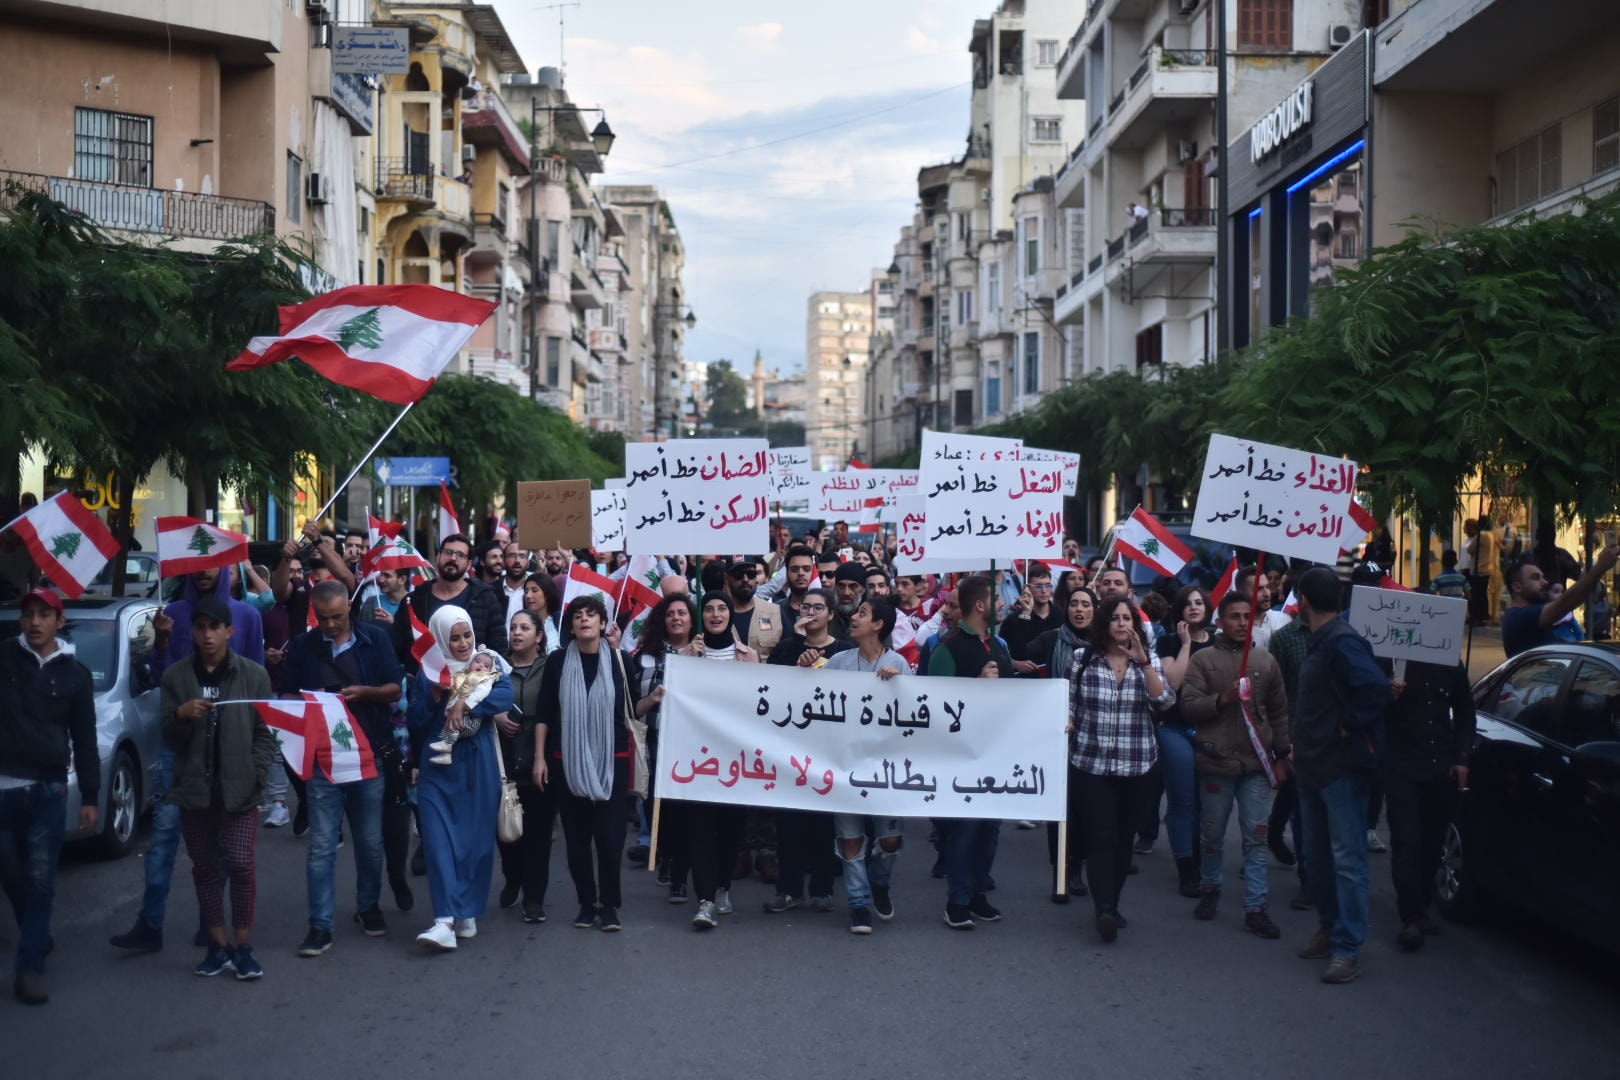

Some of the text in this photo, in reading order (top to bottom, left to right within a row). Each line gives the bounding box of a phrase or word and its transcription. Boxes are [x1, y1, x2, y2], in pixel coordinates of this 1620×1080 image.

[1251, 81, 1313, 163] NABOULSI
[626, 446, 668, 488] أحمر
[670, 456, 698, 479] خط
[700, 450, 767, 481] الضمان
[821, 475, 860, 496] للظلم
[928, 464, 1062, 499] الشغل خط أحمر
[1209, 446, 1354, 494] الغذاء خط أحمر
[593, 492, 618, 517] أحمر
[635, 489, 767, 530] السكن خط أحمر
[1207, 490, 1343, 538] الأمن خط أحمر
[930, 508, 1062, 548] الإنماء خط أحمر
[756, 684, 965, 737] لا قيادة للثورة
[671, 746, 1045, 803] الشعب يطالب ولا يفاوض
